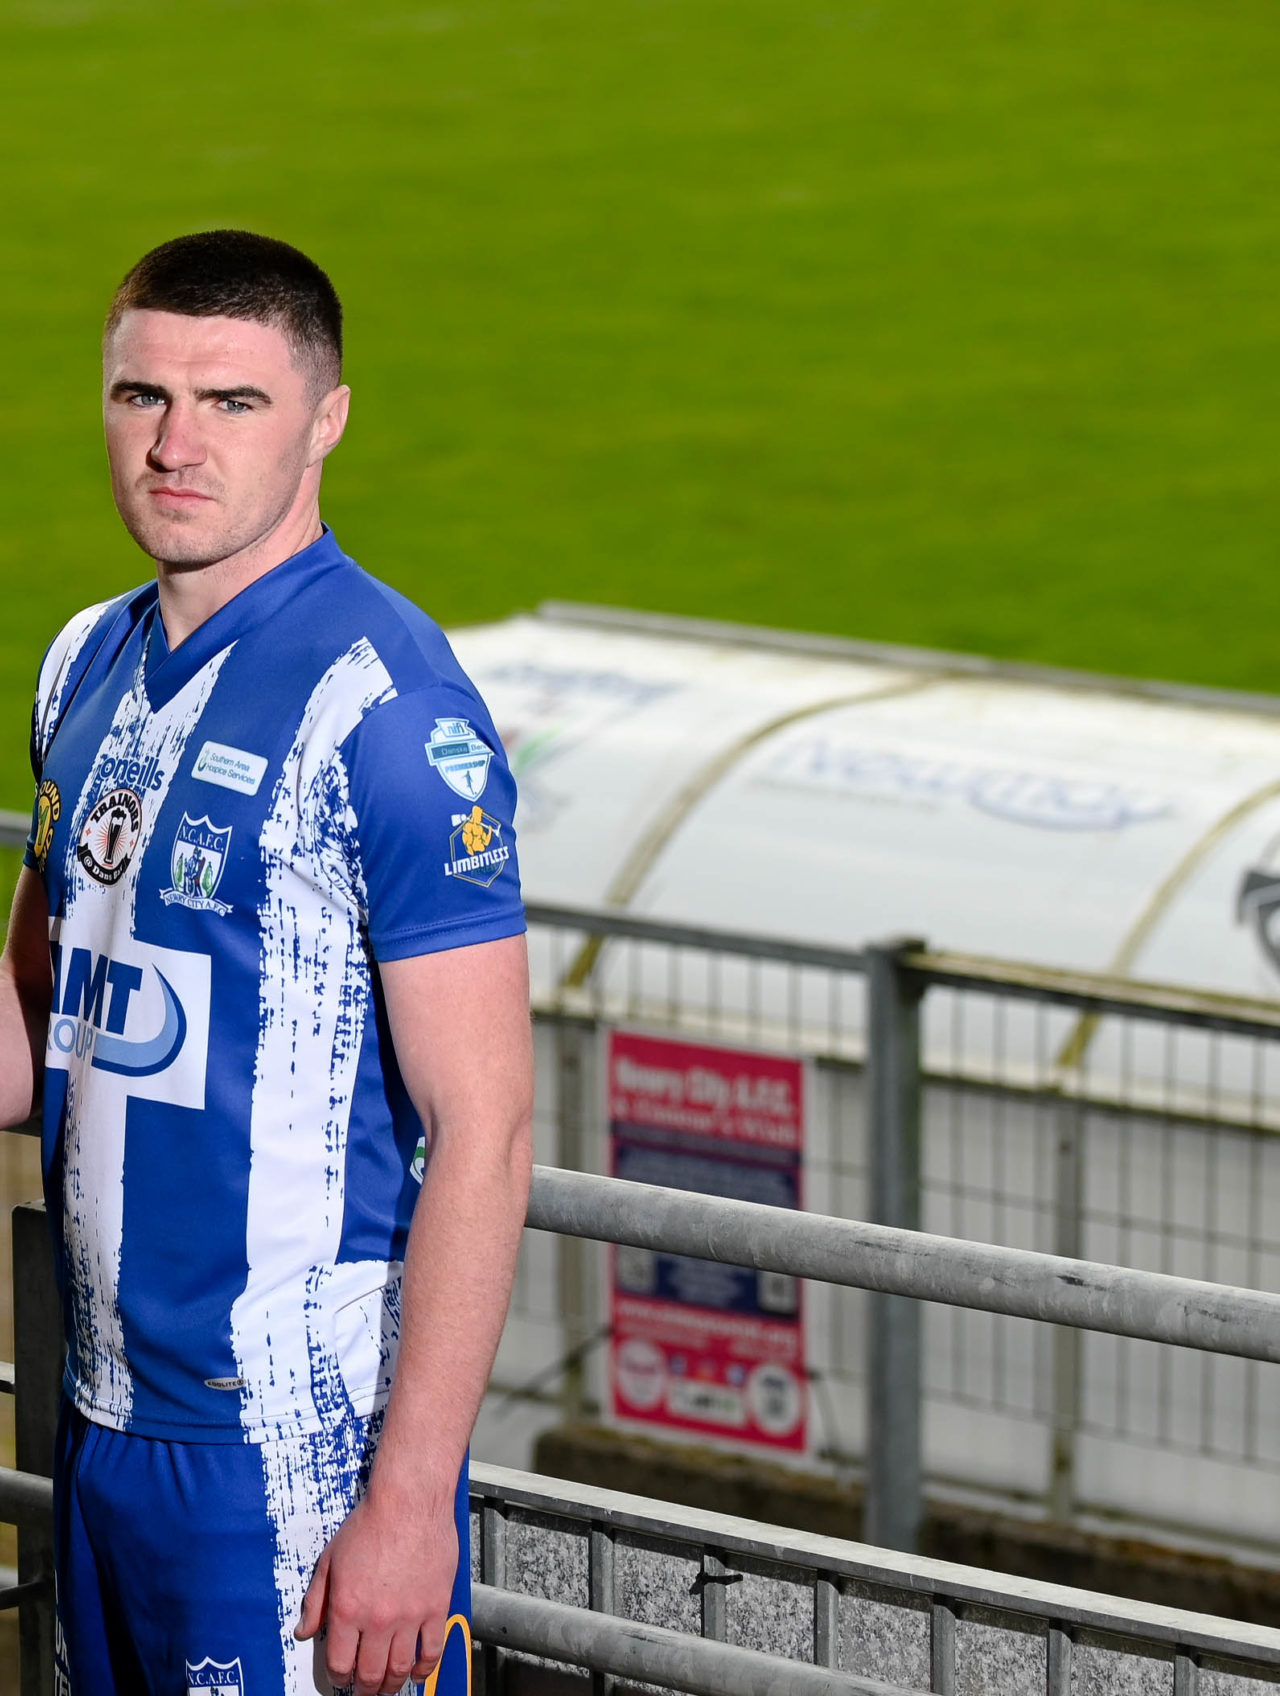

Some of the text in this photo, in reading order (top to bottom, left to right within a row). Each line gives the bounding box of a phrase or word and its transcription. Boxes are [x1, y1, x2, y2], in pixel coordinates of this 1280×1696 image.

[227, 769, 256, 785] Services
[234, 760, 250, 772] Area
[90, 792, 139, 832] TRAINORS
[444, 846, 510, 877] LIMBITLESS
